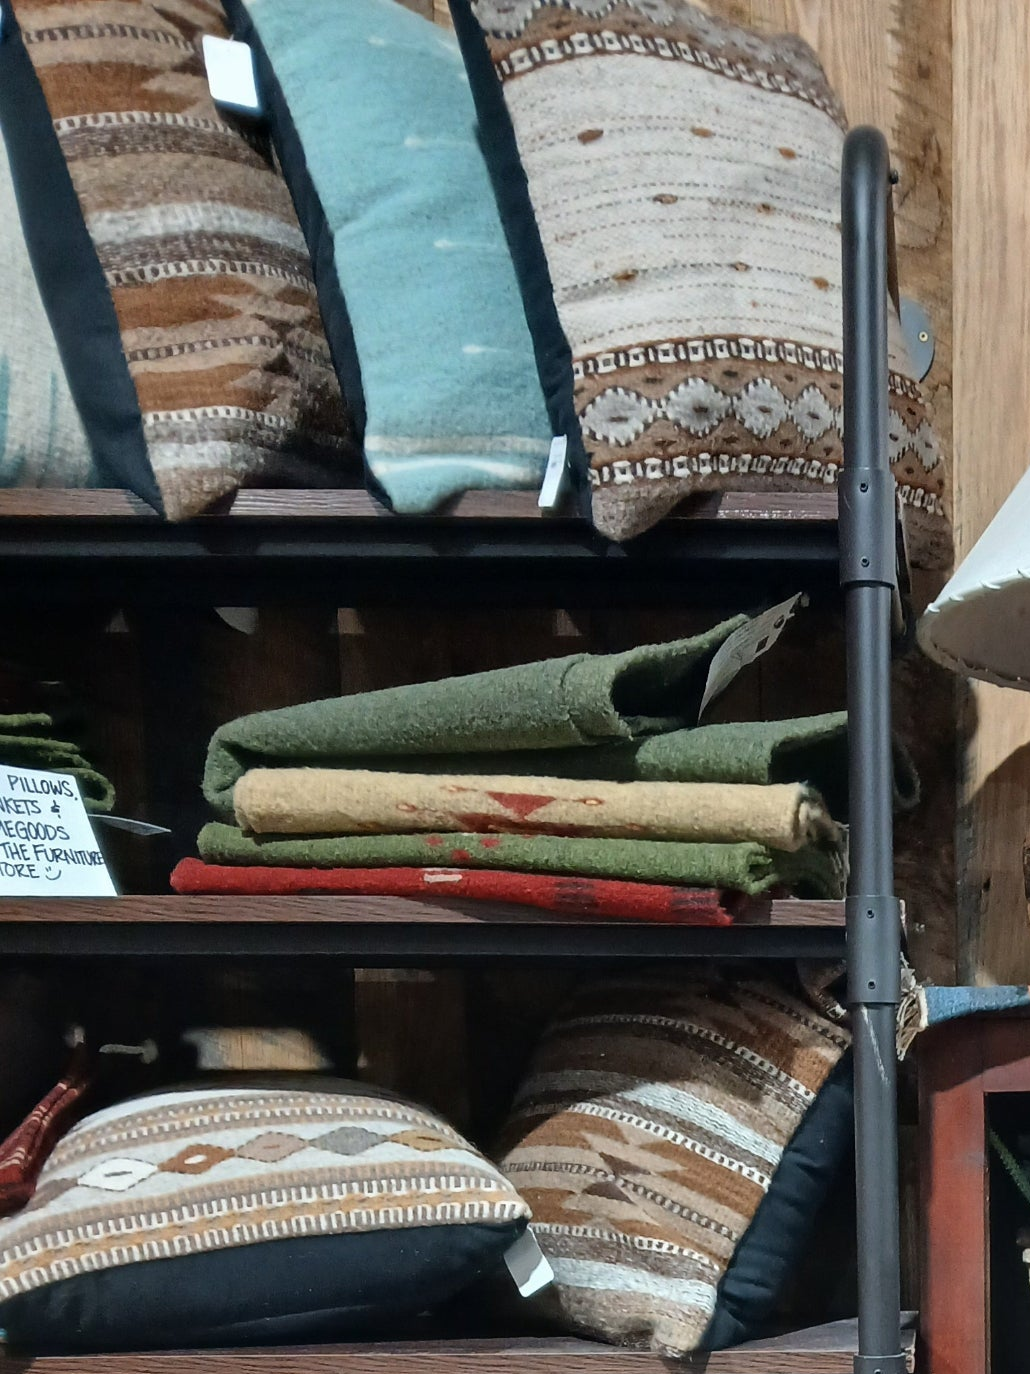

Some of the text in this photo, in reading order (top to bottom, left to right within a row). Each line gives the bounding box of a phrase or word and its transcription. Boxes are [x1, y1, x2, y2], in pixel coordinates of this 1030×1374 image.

[0, 796, 41, 816] KETS
[0, 820, 70, 841] EGOODS
[0, 841, 105, 867] THE FURNITURE
[0, 861, 40, 878] TORE
